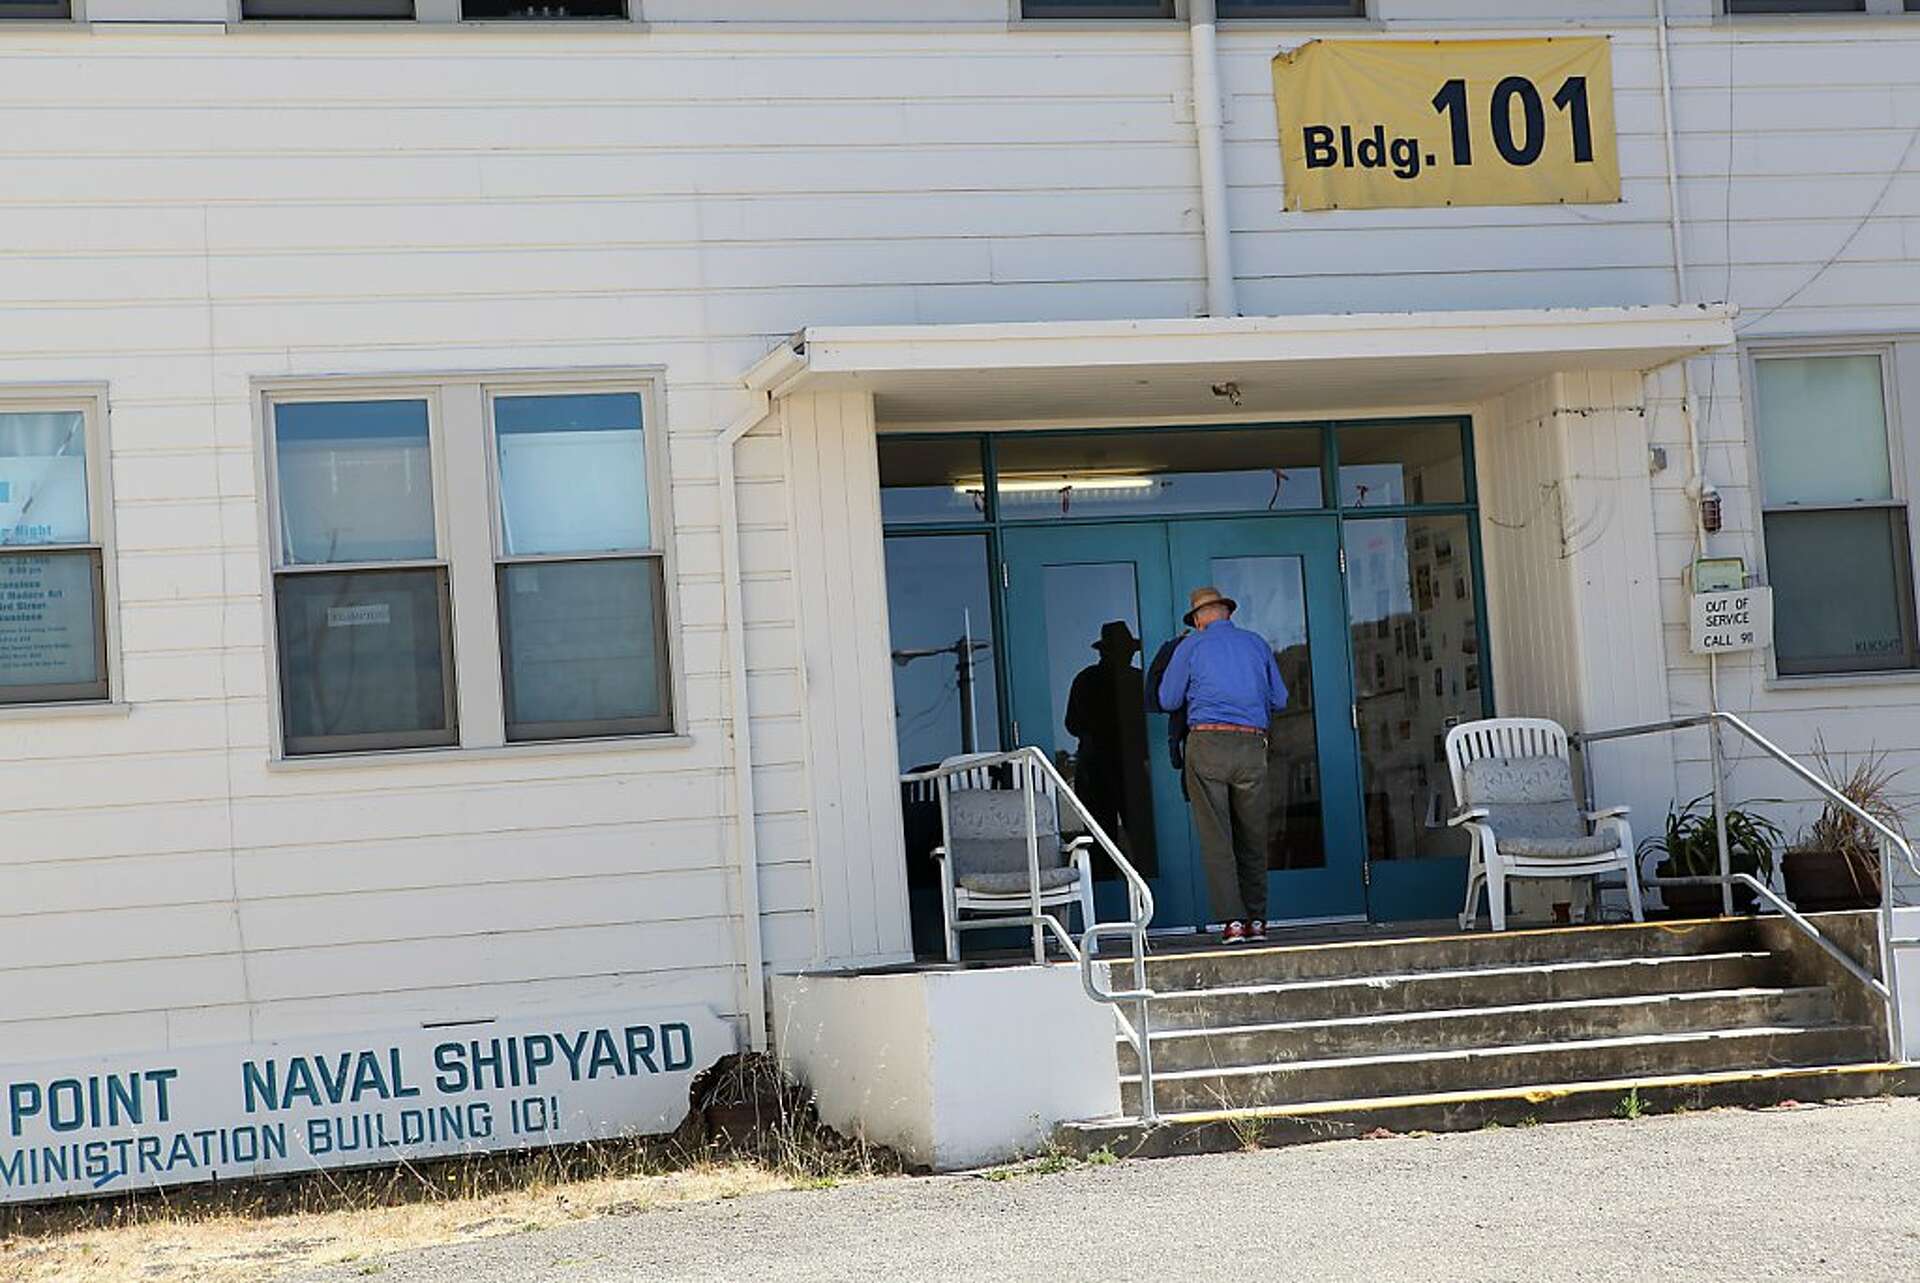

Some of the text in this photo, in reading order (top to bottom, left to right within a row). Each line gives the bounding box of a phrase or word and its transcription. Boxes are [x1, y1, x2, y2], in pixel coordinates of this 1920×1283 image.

[1303, 76, 1594, 179] Bldg. 101
[1705, 598, 1749, 613] OUT OF
[1706, 612, 1750, 627] SERVICE
[1703, 633, 1733, 647] CALL
[9, 1022, 693, 1136] POINT NAVAL SHIPYARD
[0, 1122, 287, 1188] MINISTRATION
[307, 1103, 493, 1156] BUILDING
